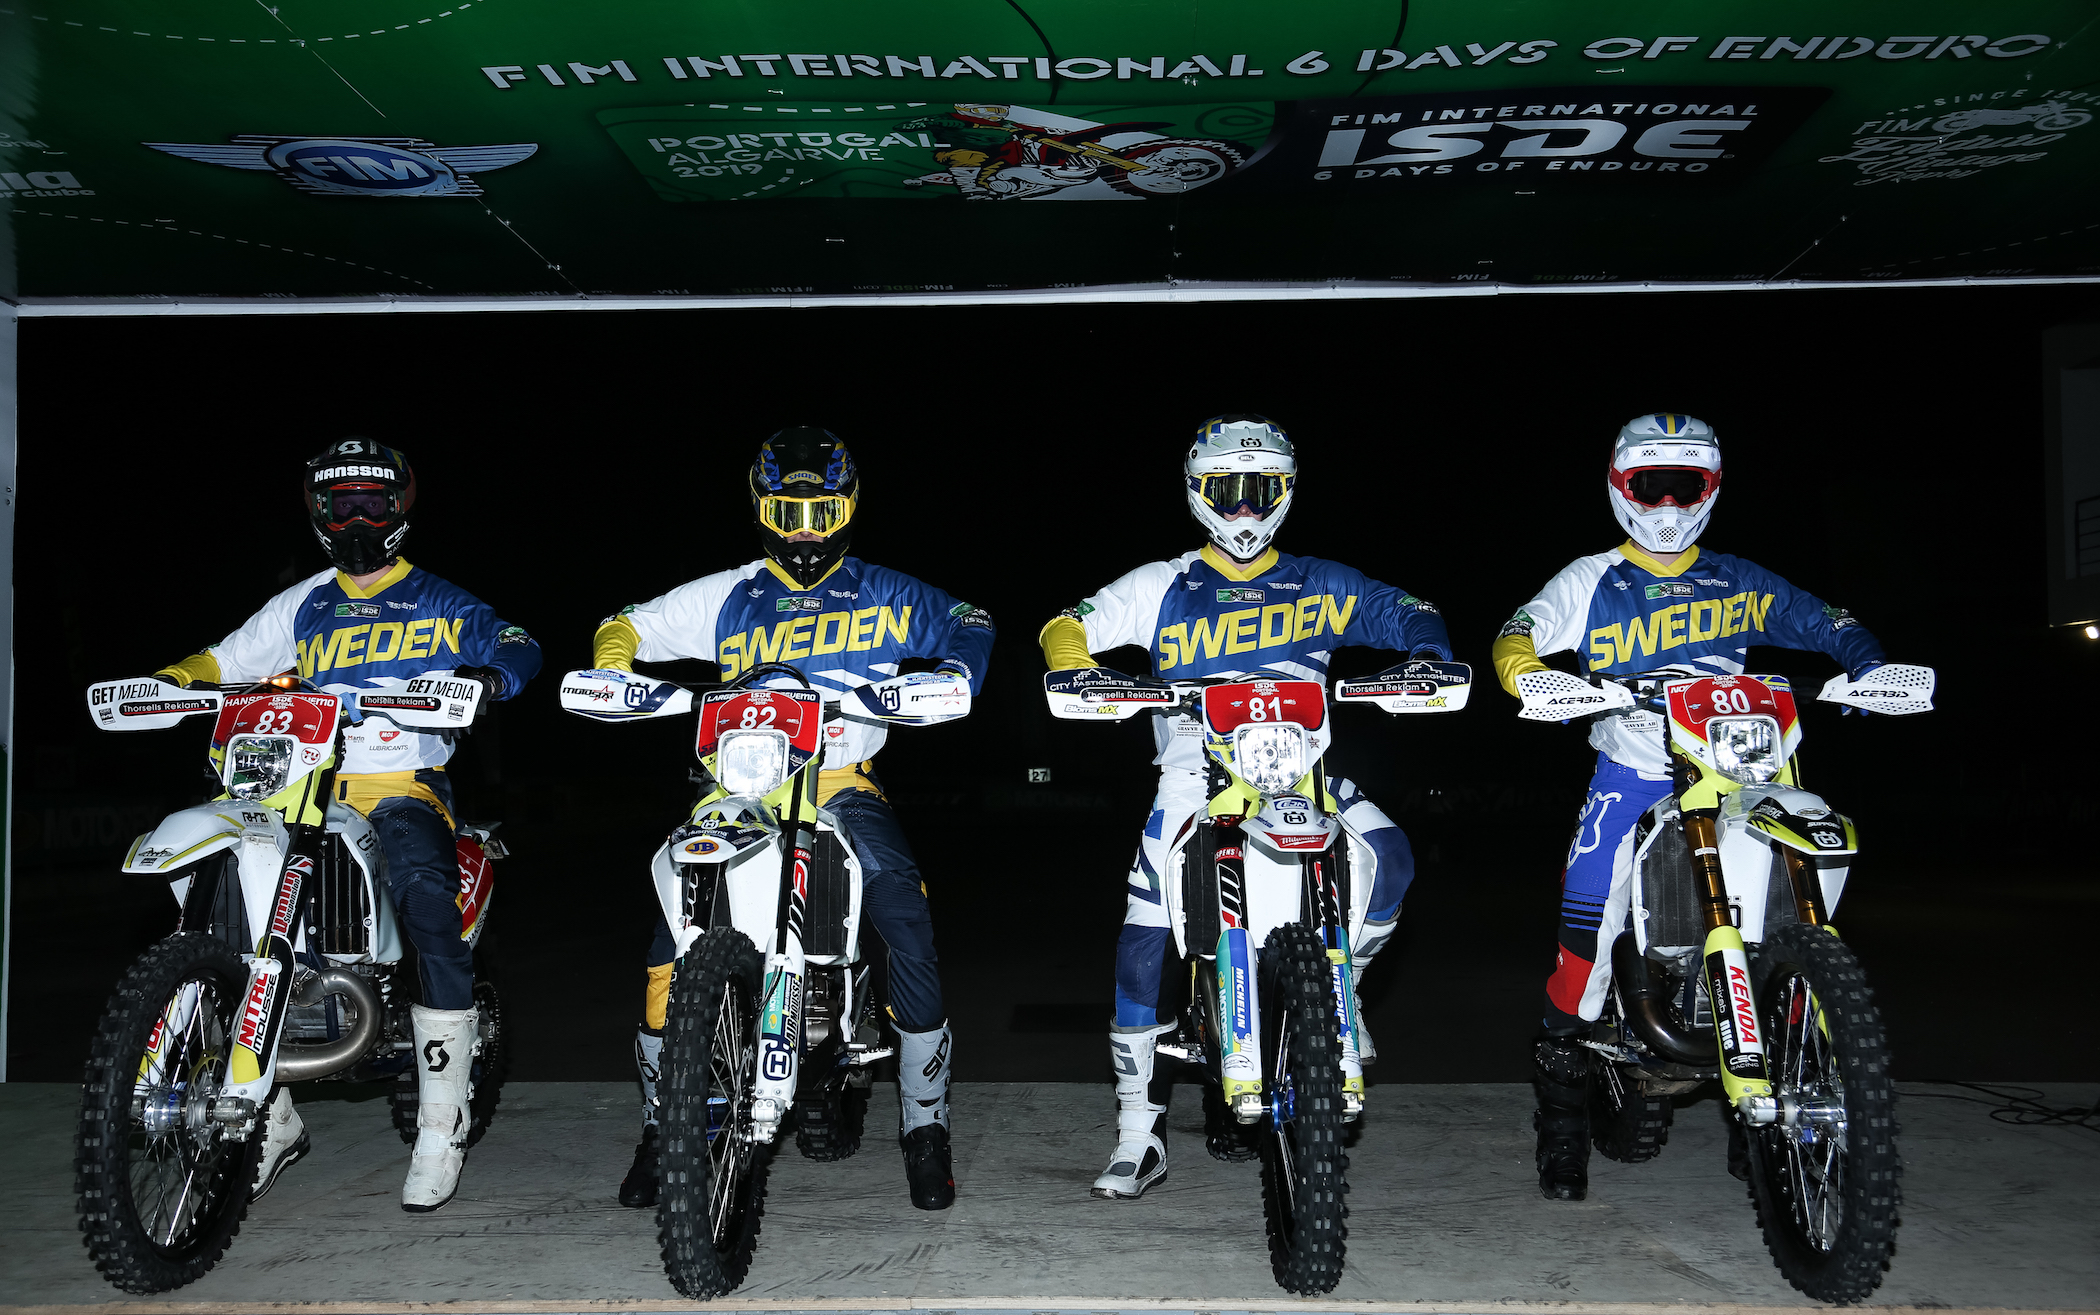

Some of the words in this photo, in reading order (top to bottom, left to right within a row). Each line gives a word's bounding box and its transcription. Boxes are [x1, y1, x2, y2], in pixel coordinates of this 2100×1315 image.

[480, 60, 638, 89] FIM
[663, 54, 1264, 80] INTERNATIONAL
[1284, 50, 1331, 75] 6
[1356, 39, 1559, 74] DAYS
[1581, 36, 1701, 60] OF
[1708, 34, 2050, 61] ENDURO
[1933, 88, 2029, 106] SINCE
[1330, 111, 1402, 126] FIM
[1421, 102, 1759, 122] INTERNATIONAL
[1851, 116, 1934, 136] FIM
[647, 132, 952, 153] PORTUGAL
[1317, 120, 1752, 167] ISDE
[667, 148, 884, 166] ALGARVE
[295, 155, 428, 183] FIM
[672, 163, 763, 178] 2019
[1313, 170, 1333, 181] 6
[1354, 164, 1453, 179] DAYS
[1475, 161, 1525, 173] OF
[1543, 160, 1710, 174] ENDURO
[314, 466, 395, 483] HANSSON
[1159, 594, 1357, 671] SWEDEN
[1588, 591, 1775, 672] SWEDEN
[719, 606, 912, 683] SWEDEN
[1049, 682, 1071, 692] CITY
[1073, 680, 1135, 688] FASTIGHETER
[1345, 684, 1383, 694] Thorsells
[1386, 682, 1420, 691] Reklam
[1379, 673, 1402, 681] CITY
[1404, 673, 1466, 684] FASTIGHETER
[92, 686, 116, 706] GET
[118, 683, 159, 701] MEDIA
[406, 679, 434, 694] GET
[433, 681, 474, 703] MEDIA
[1086, 690, 1125, 699] Thorsells
[1127, 691, 1160, 699] Reklam
[1547, 696, 1606, 705] ACERBIS
[1711, 688, 1751, 714] 80
[1847, 690, 1909, 698] ACERBIS
[123, 703, 161, 713] Thorsells
[164, 701, 200, 710] Reklam
[396, 697, 426, 707] Reklam
[1248, 697, 1283, 722] 81
[253, 710, 294, 735] 83
[740, 706, 778, 729] 82
[369, 744, 409, 752] LUBRICANTS
[1032, 770, 1047, 781] 27
[1281, 836, 1323, 845] Milwaukee
[1235, 967, 1246, 1029] MICHELIN
[1332, 964, 1346, 1025] MICHELIN
[1729, 965, 1758, 1043] KENDA
[1218, 989, 1229, 1051] MOTOREX
[1730, 1062, 1760, 1071] RACING
